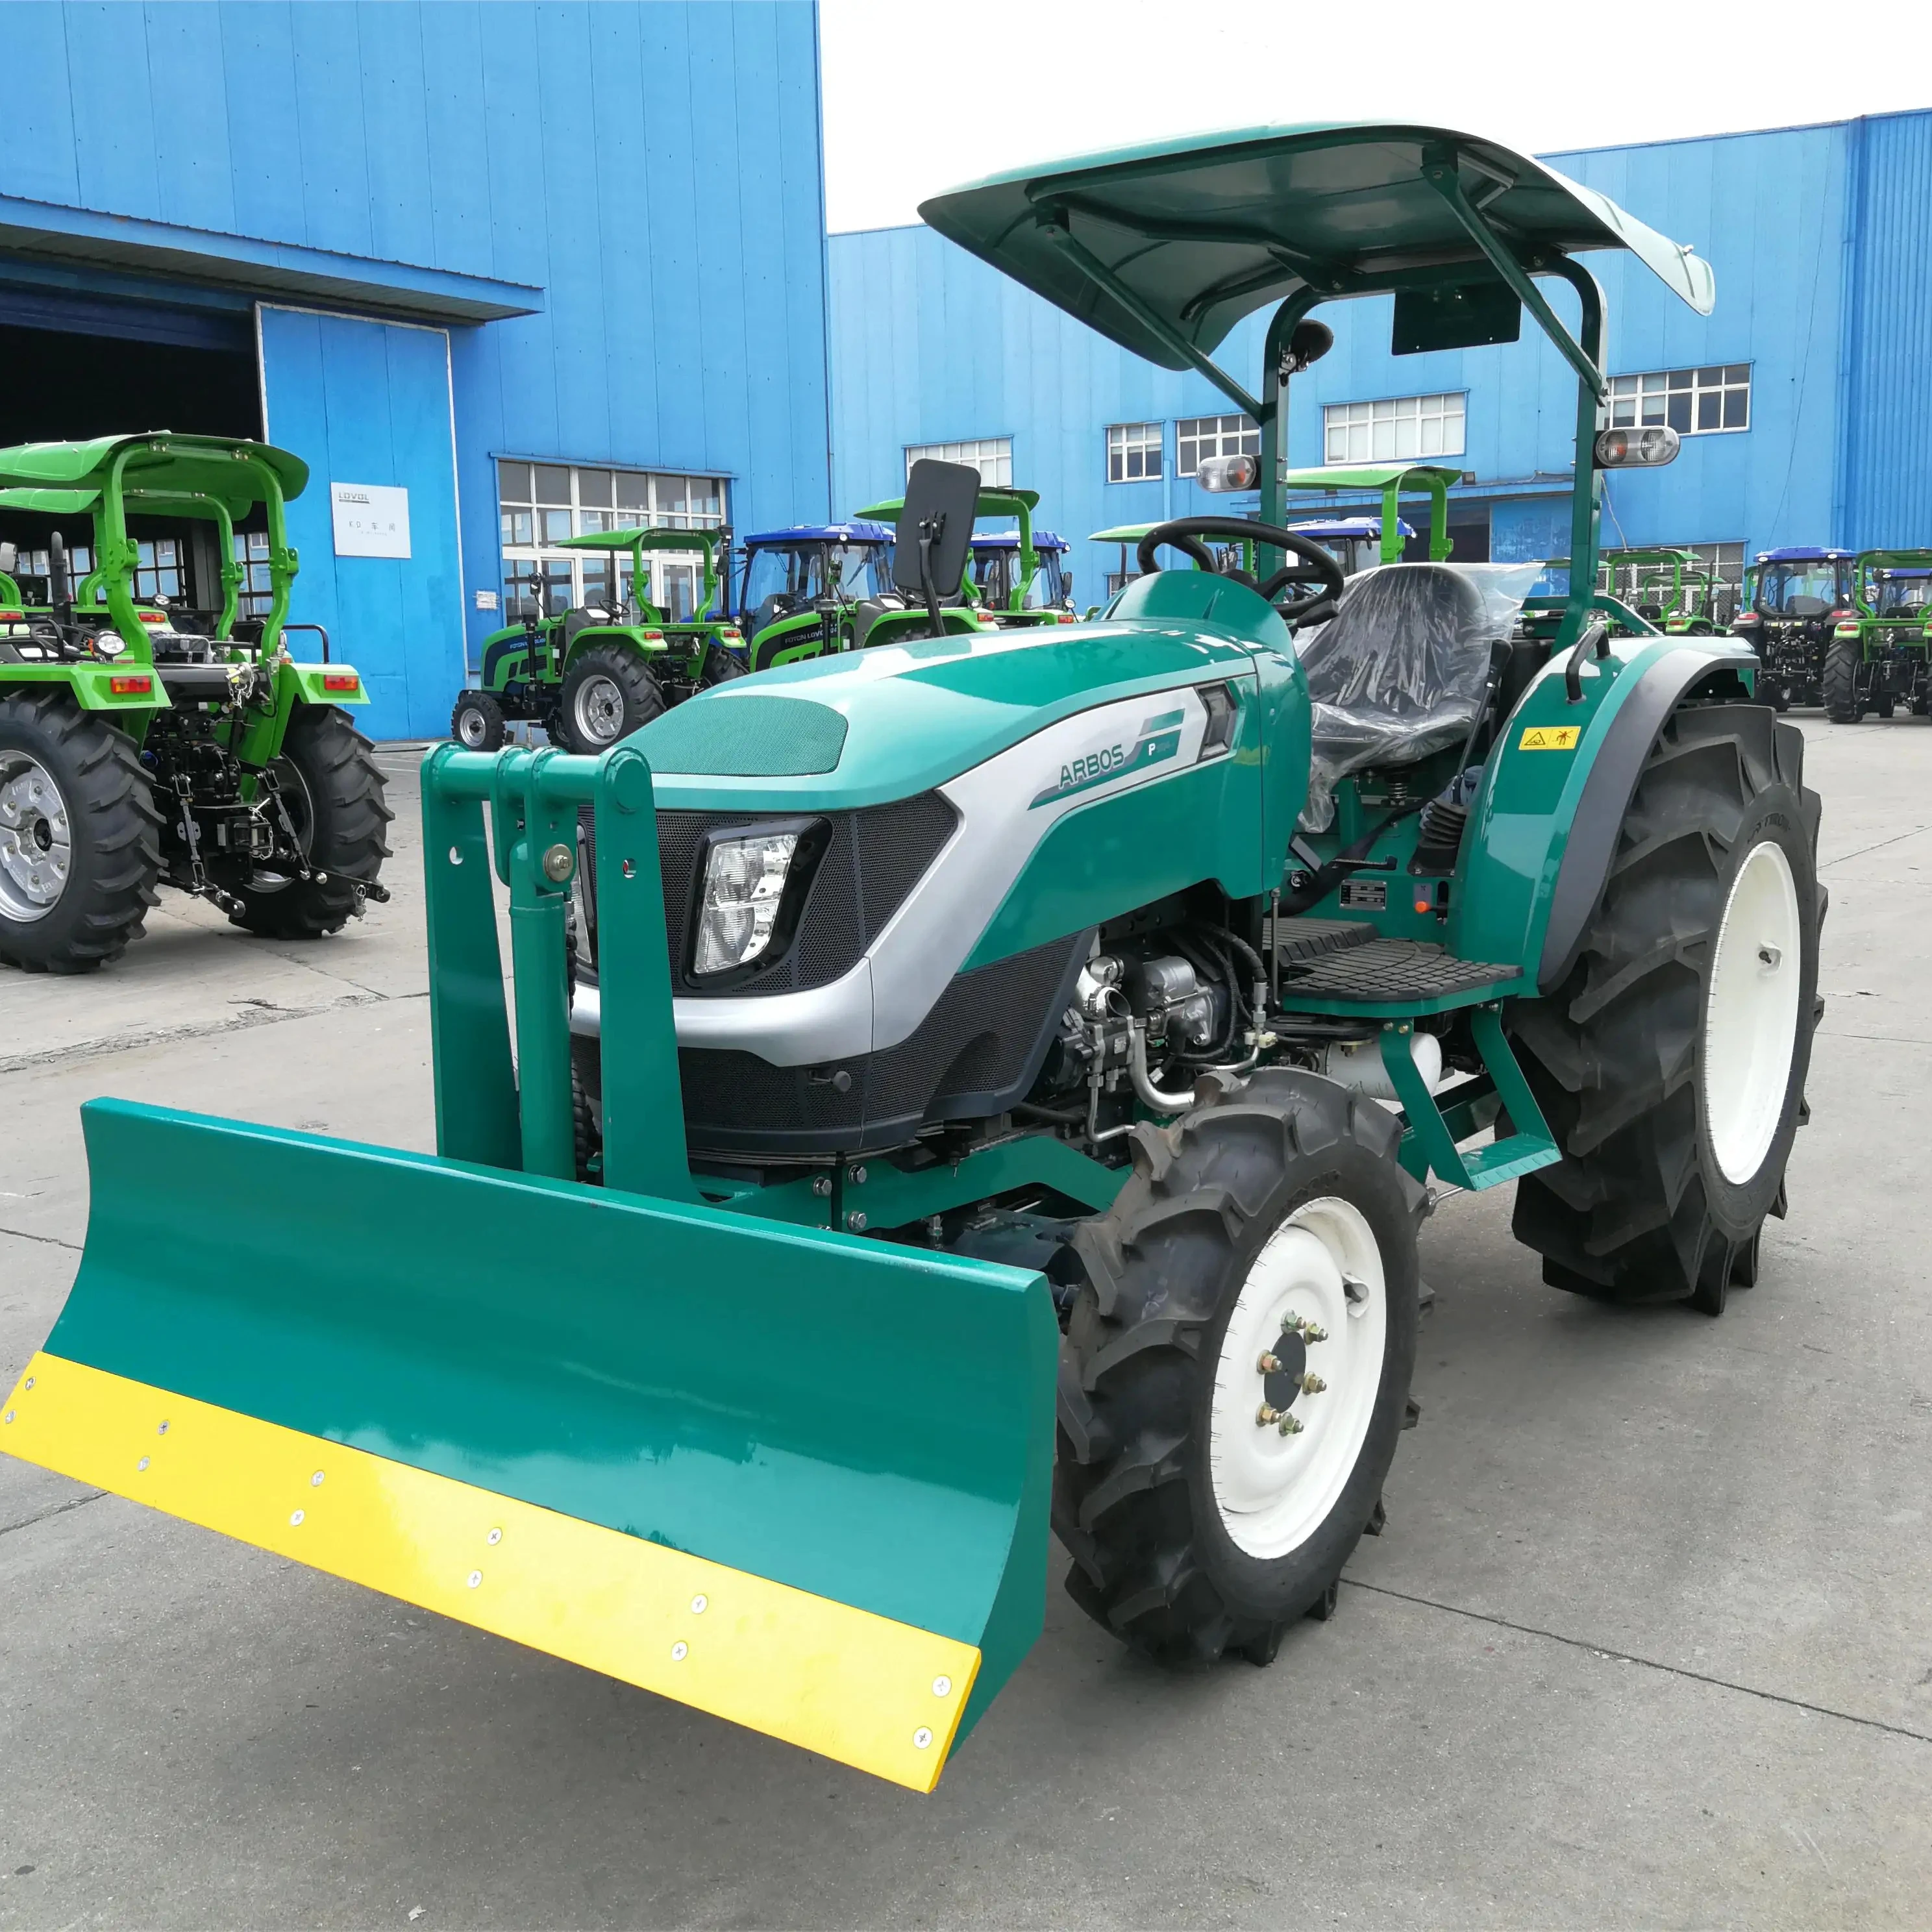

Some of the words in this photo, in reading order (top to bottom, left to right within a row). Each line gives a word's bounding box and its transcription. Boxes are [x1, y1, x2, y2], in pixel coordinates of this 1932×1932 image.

[338, 492, 369, 501] LOVOL
[784, 634, 806, 644] FOTON
[1059, 744, 1124, 789] ARBOS
